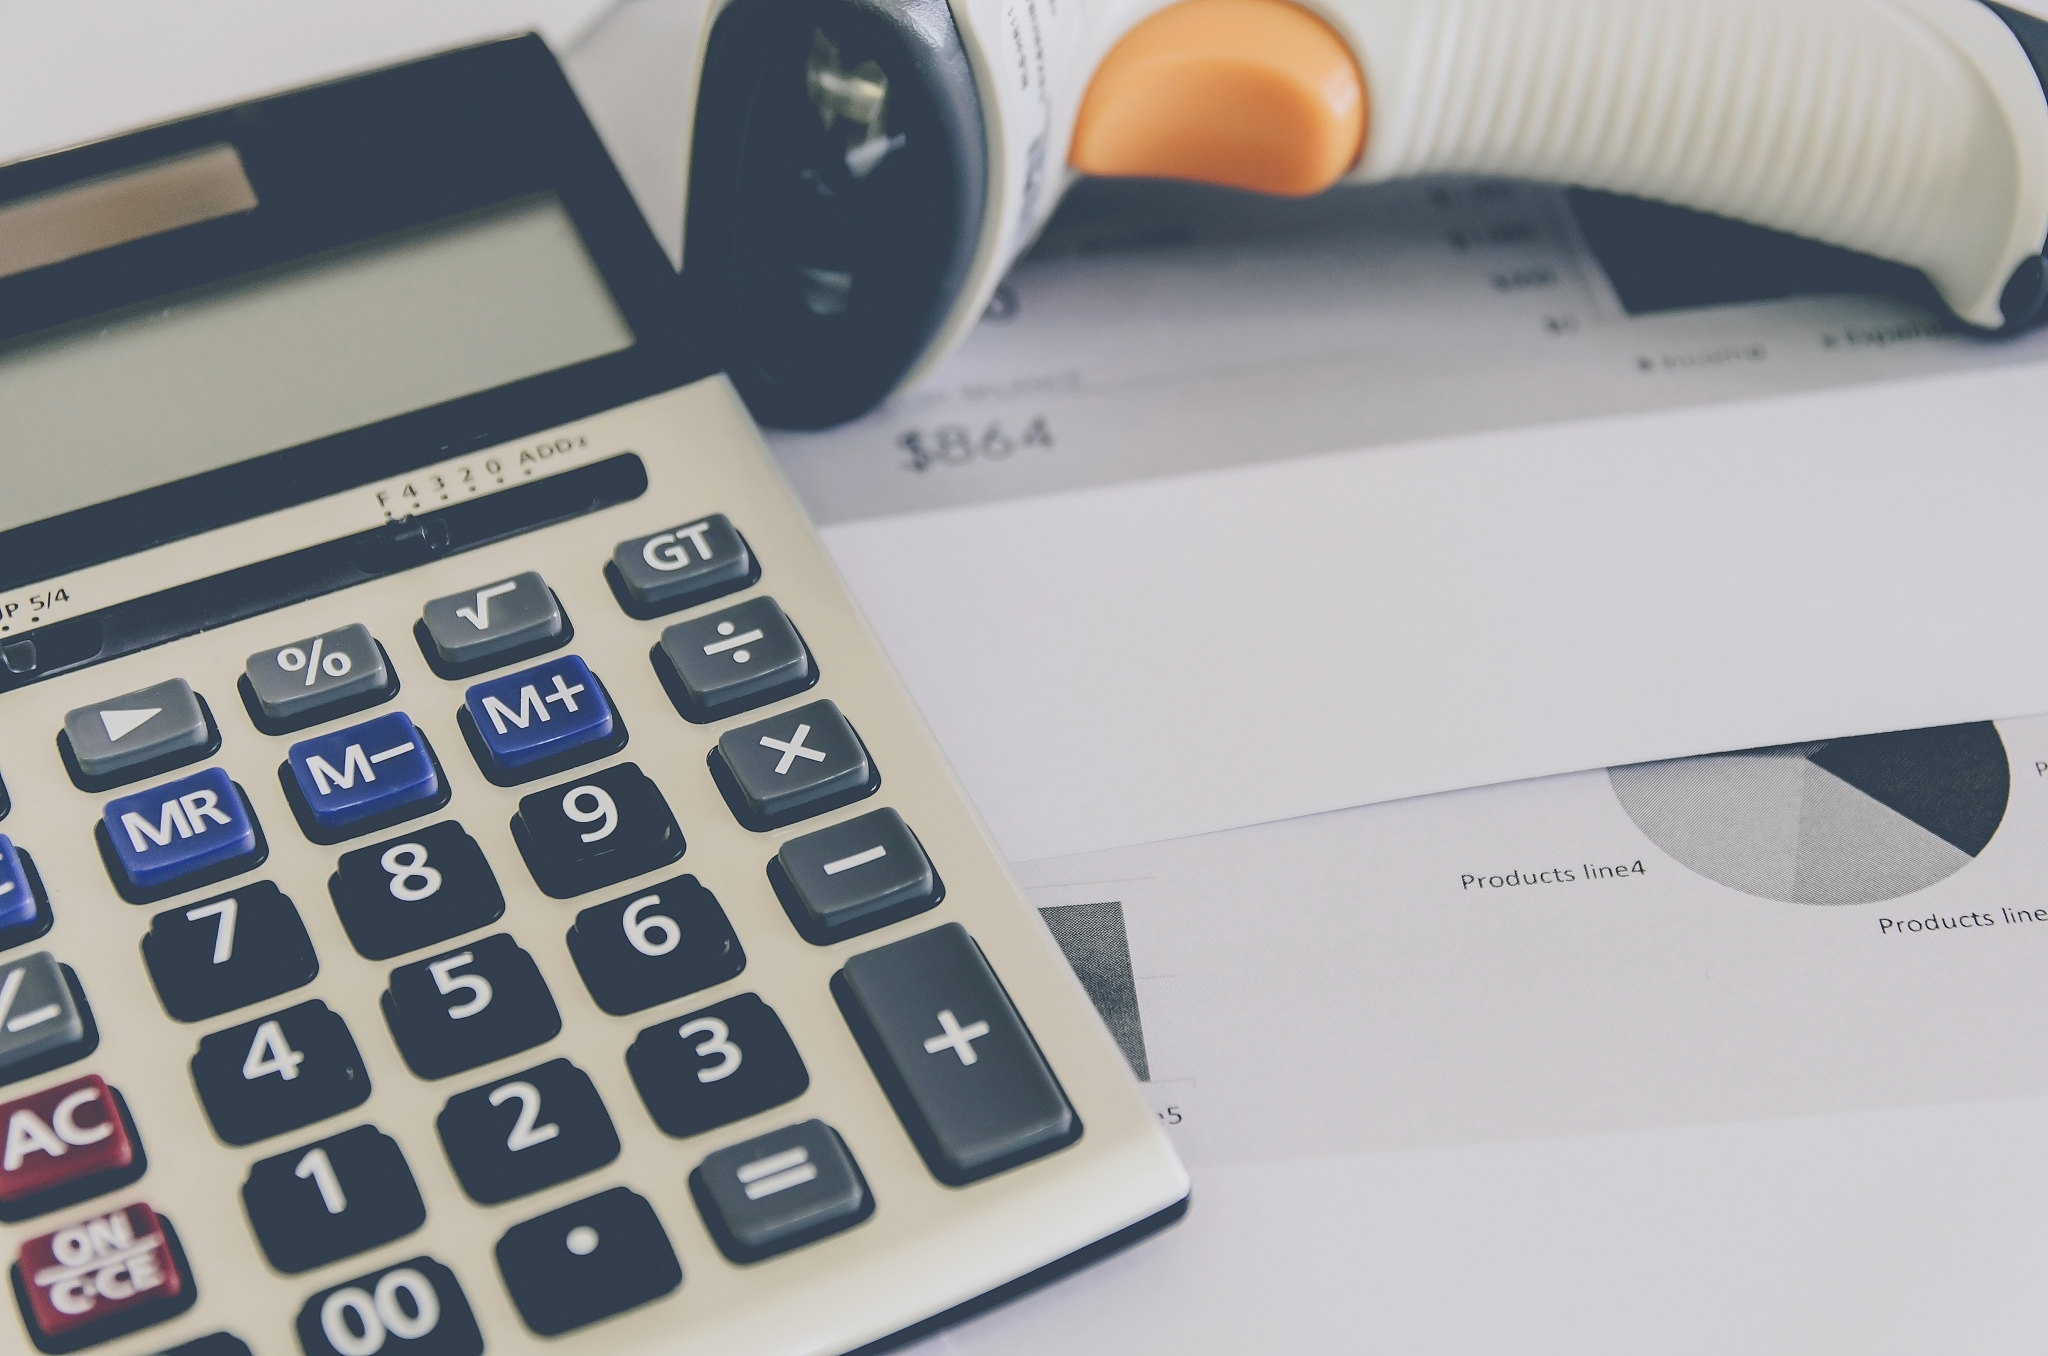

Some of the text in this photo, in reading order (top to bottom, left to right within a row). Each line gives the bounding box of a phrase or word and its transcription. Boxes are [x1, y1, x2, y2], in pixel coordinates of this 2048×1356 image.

[897, 416, 1055, 475] $864
[402, 483, 417, 499] 4
[458, 467, 472, 483] 2
[642, 522, 711, 572] GT
[29, 588, 70, 612] 5/4
[276, 637, 352, 686] %
[481, 674, 585, 735] M+
[305, 741, 415, 796] M-
[120, 788, 232, 853] MR
[562, 784, 619, 843] 9
[380, 842, 442, 902] 8
[1461, 860, 1647, 890] Products line4
[185, 897, 238, 965] 7
[621, 894, 682, 957] 6
[1879, 907, 2048, 935] Products line
[425, 951, 493, 1019] 5
[242, 1020, 305, 1081] 4
[678, 1016, 743, 1083] 3
[3, 1086, 114, 1171] AC
[488, 1081, 561, 1152] 2
[294, 1147, 348, 1214] 1
[52, 1210, 135, 1268] ON
[320, 1267, 442, 1356] 00
